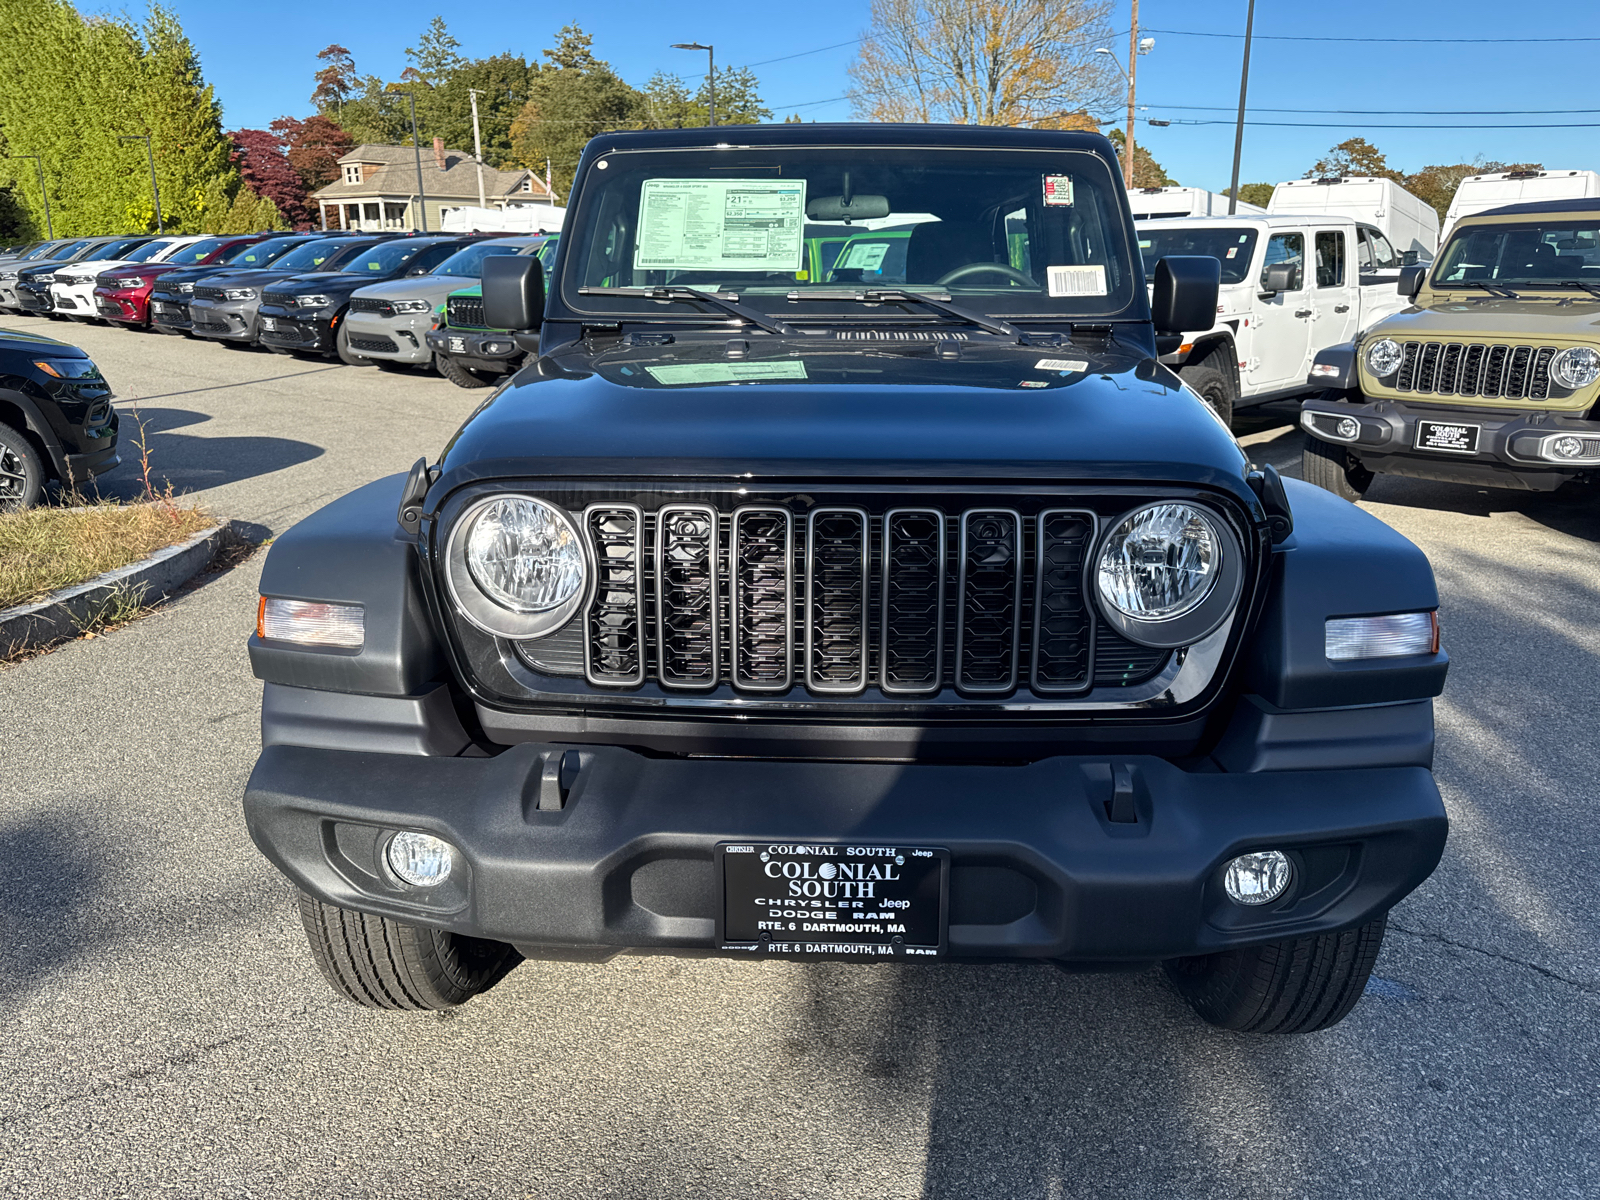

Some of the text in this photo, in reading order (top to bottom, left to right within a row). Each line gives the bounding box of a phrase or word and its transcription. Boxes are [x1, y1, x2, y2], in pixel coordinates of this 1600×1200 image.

[1430, 425, 1467, 434] COLONIAL
[768, 846, 896, 857] COLONIAL SOUTH
[912, 850, 933, 858] Jeep
[764, 861, 900, 880] COLONIAL
[788, 880, 876, 898] SOUTH
[754, 898, 910, 910] CHRYSLER Jeep
[769, 910, 837, 919] DODGE
[758, 921, 906, 934] RTE. 6 DARTMOUTH, MA
[769, 944, 894, 955] RTE. 6 DARTMOUTH, MA
